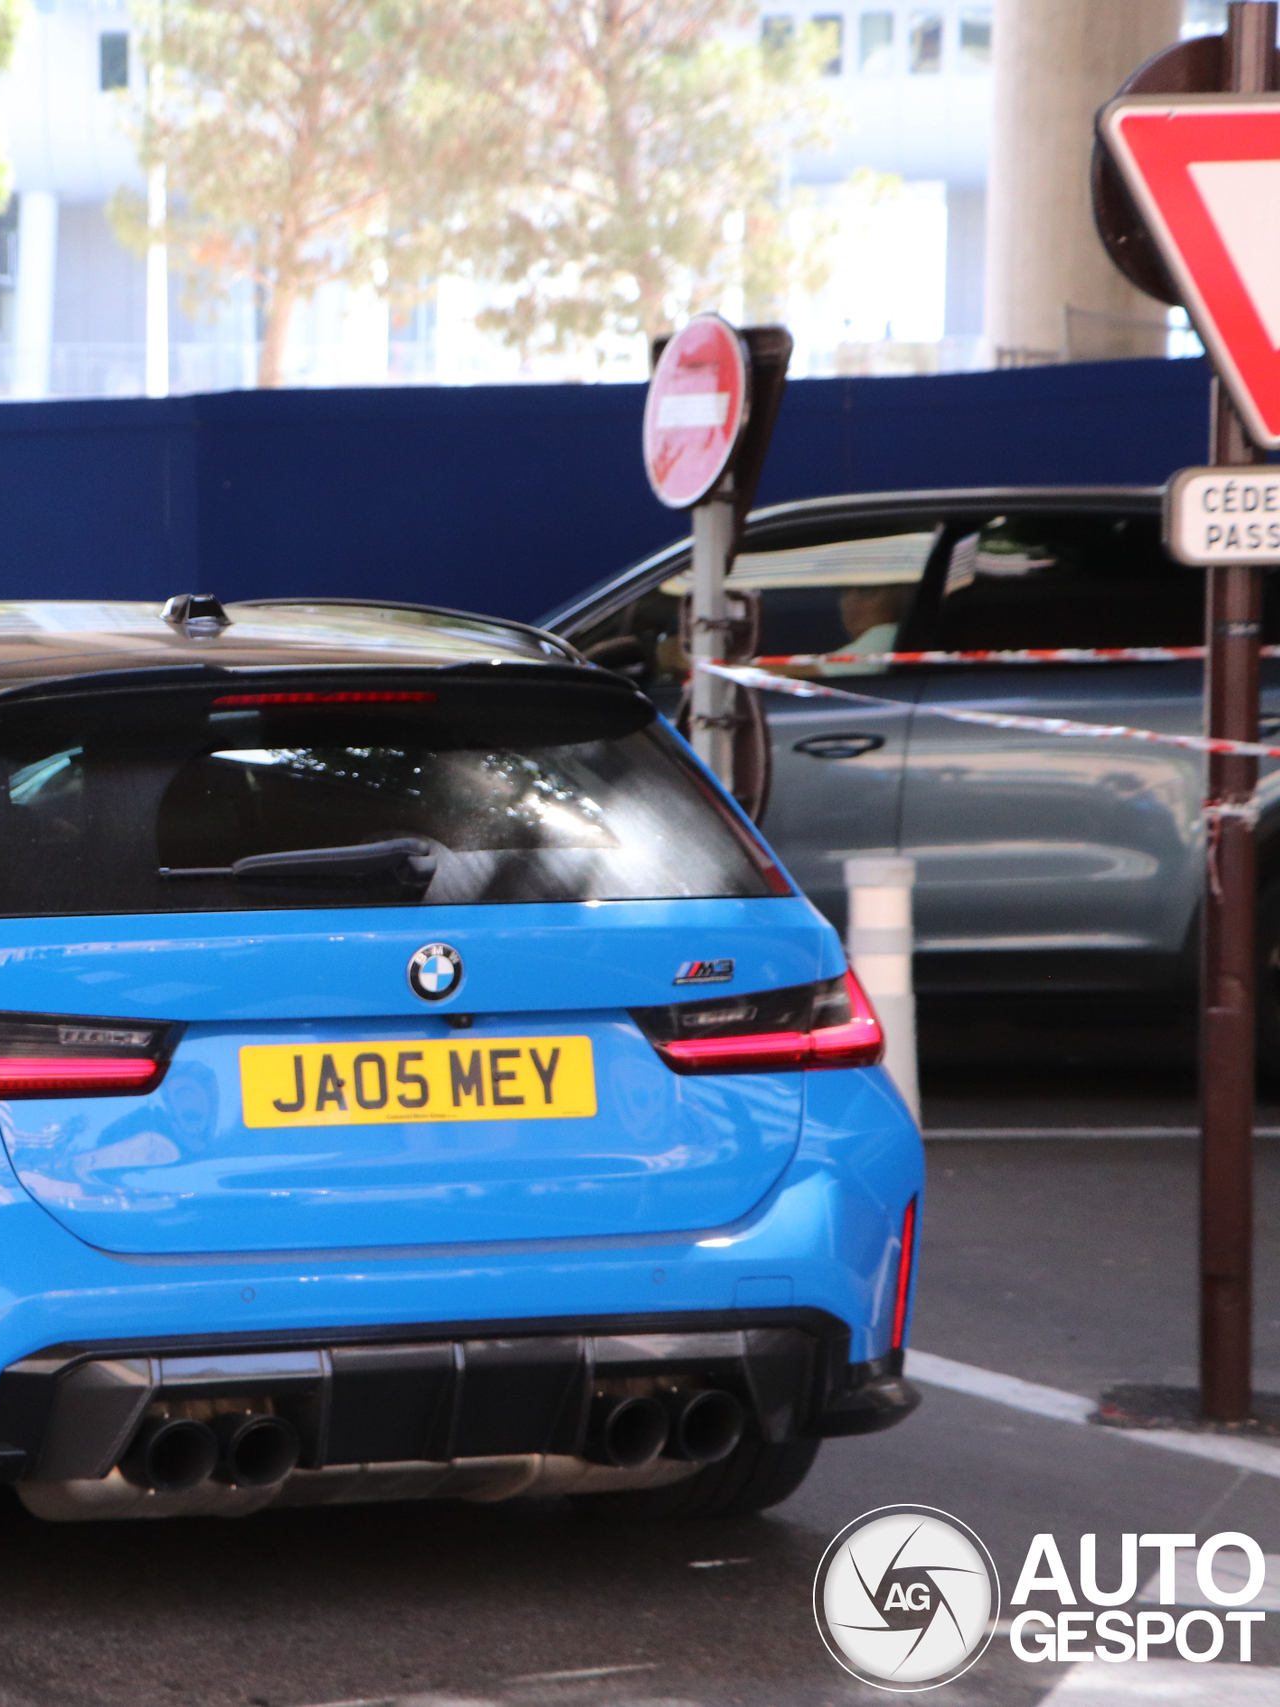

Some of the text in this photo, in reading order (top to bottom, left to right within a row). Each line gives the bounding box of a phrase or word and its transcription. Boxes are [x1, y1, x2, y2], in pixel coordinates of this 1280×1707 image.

[414, 945, 461, 965] BMW
[694, 958, 736, 977] M3
[449, 1047, 562, 1107] MEY
